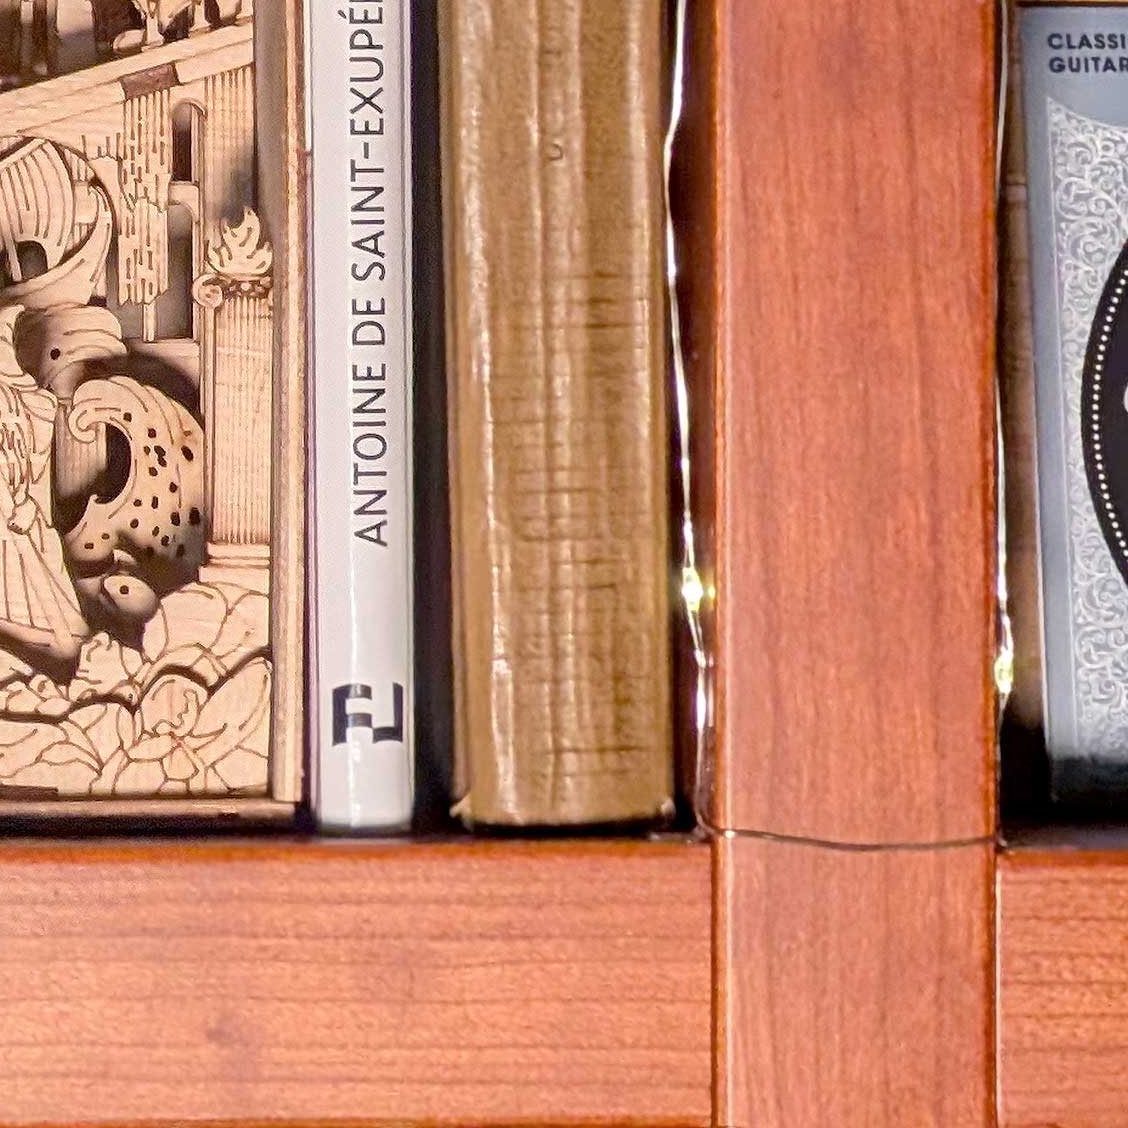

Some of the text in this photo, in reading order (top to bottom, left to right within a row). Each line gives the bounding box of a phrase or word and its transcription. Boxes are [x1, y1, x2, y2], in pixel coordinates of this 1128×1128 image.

[1047, 33, 1126, 50] CLASSI
[351, 297, 388, 347] DE
[351, 362, 390, 548] ANTOINE
